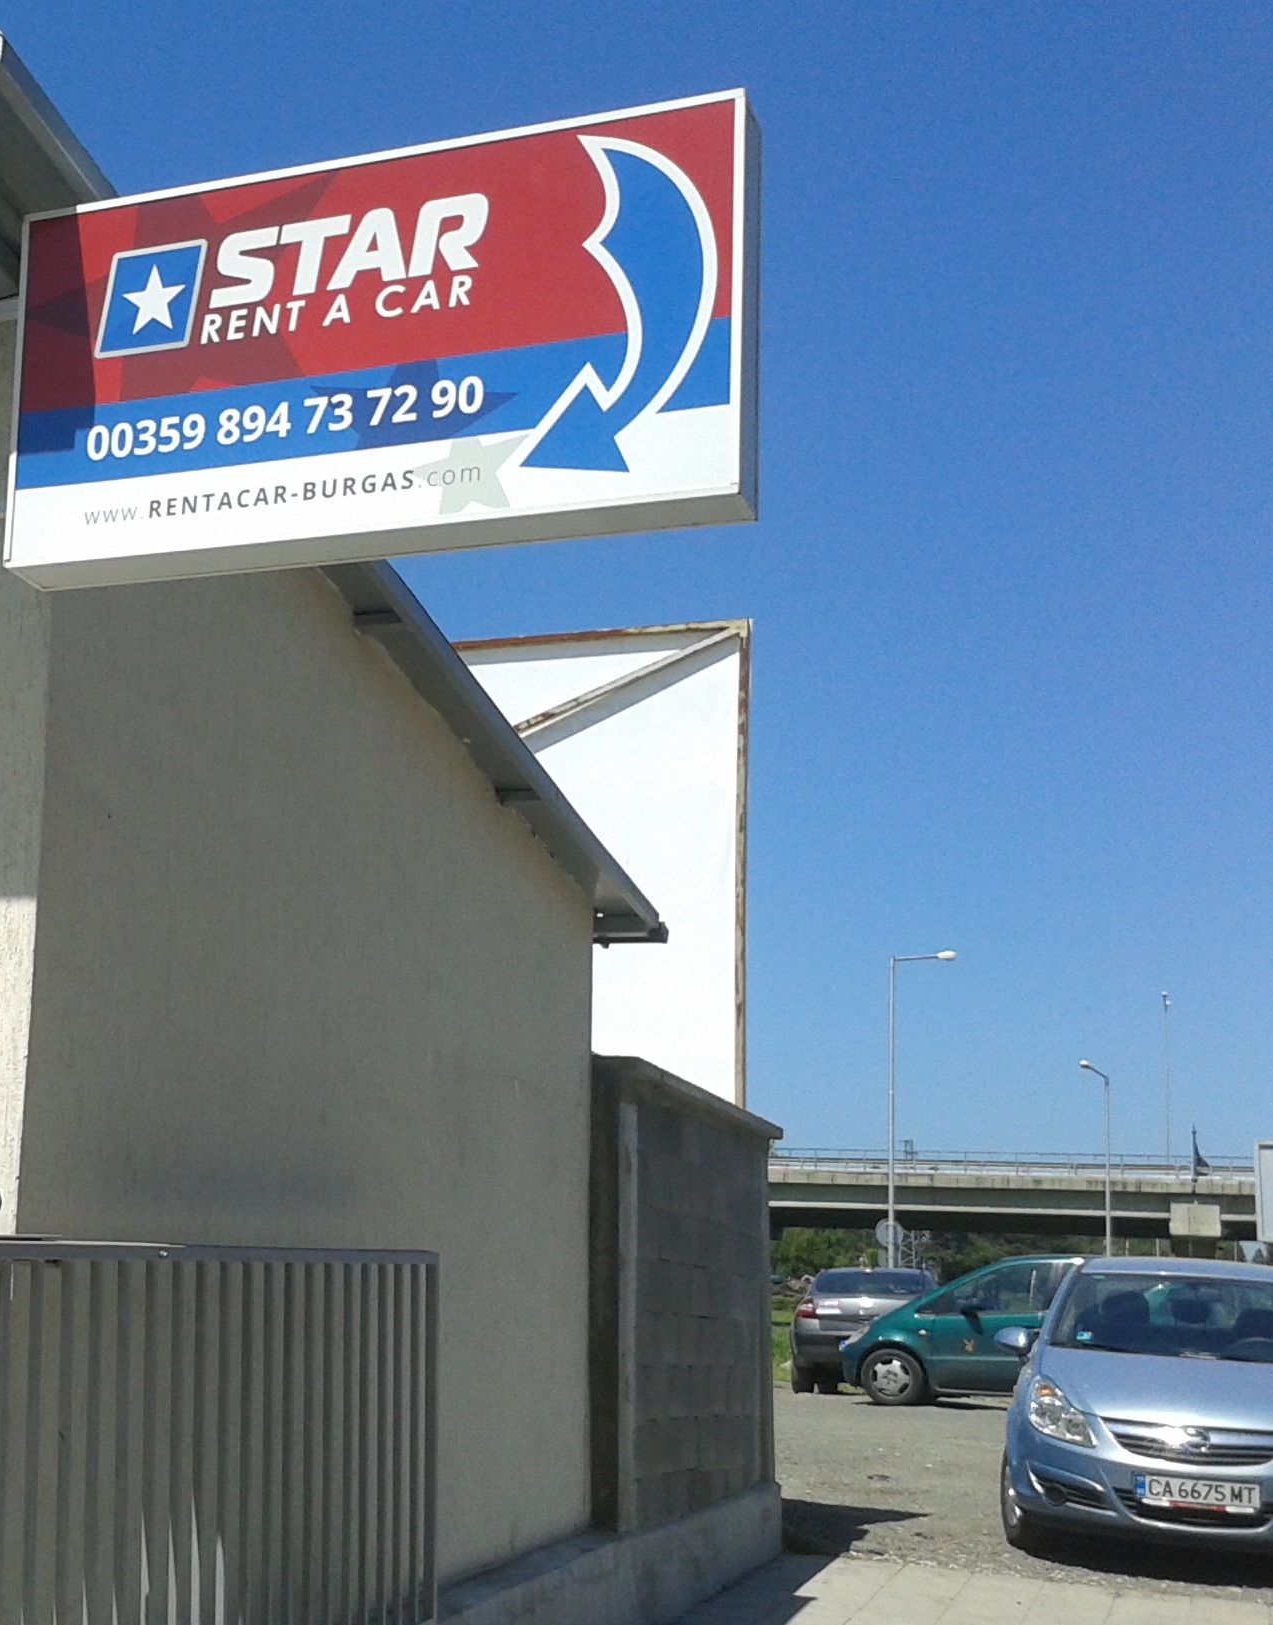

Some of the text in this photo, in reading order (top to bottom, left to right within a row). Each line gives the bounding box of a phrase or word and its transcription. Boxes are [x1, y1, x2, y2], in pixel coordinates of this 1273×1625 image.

[208, 192, 489, 309] STAR
[199, 275, 473, 345] RENT A CAR
[86, 375, 485, 461] 00359 894 73 72 90
[83, 464, 482, 526] www.RENTACAR-BURGAS.com
[1148, 1478, 1256, 1504] CA 6675 MT
